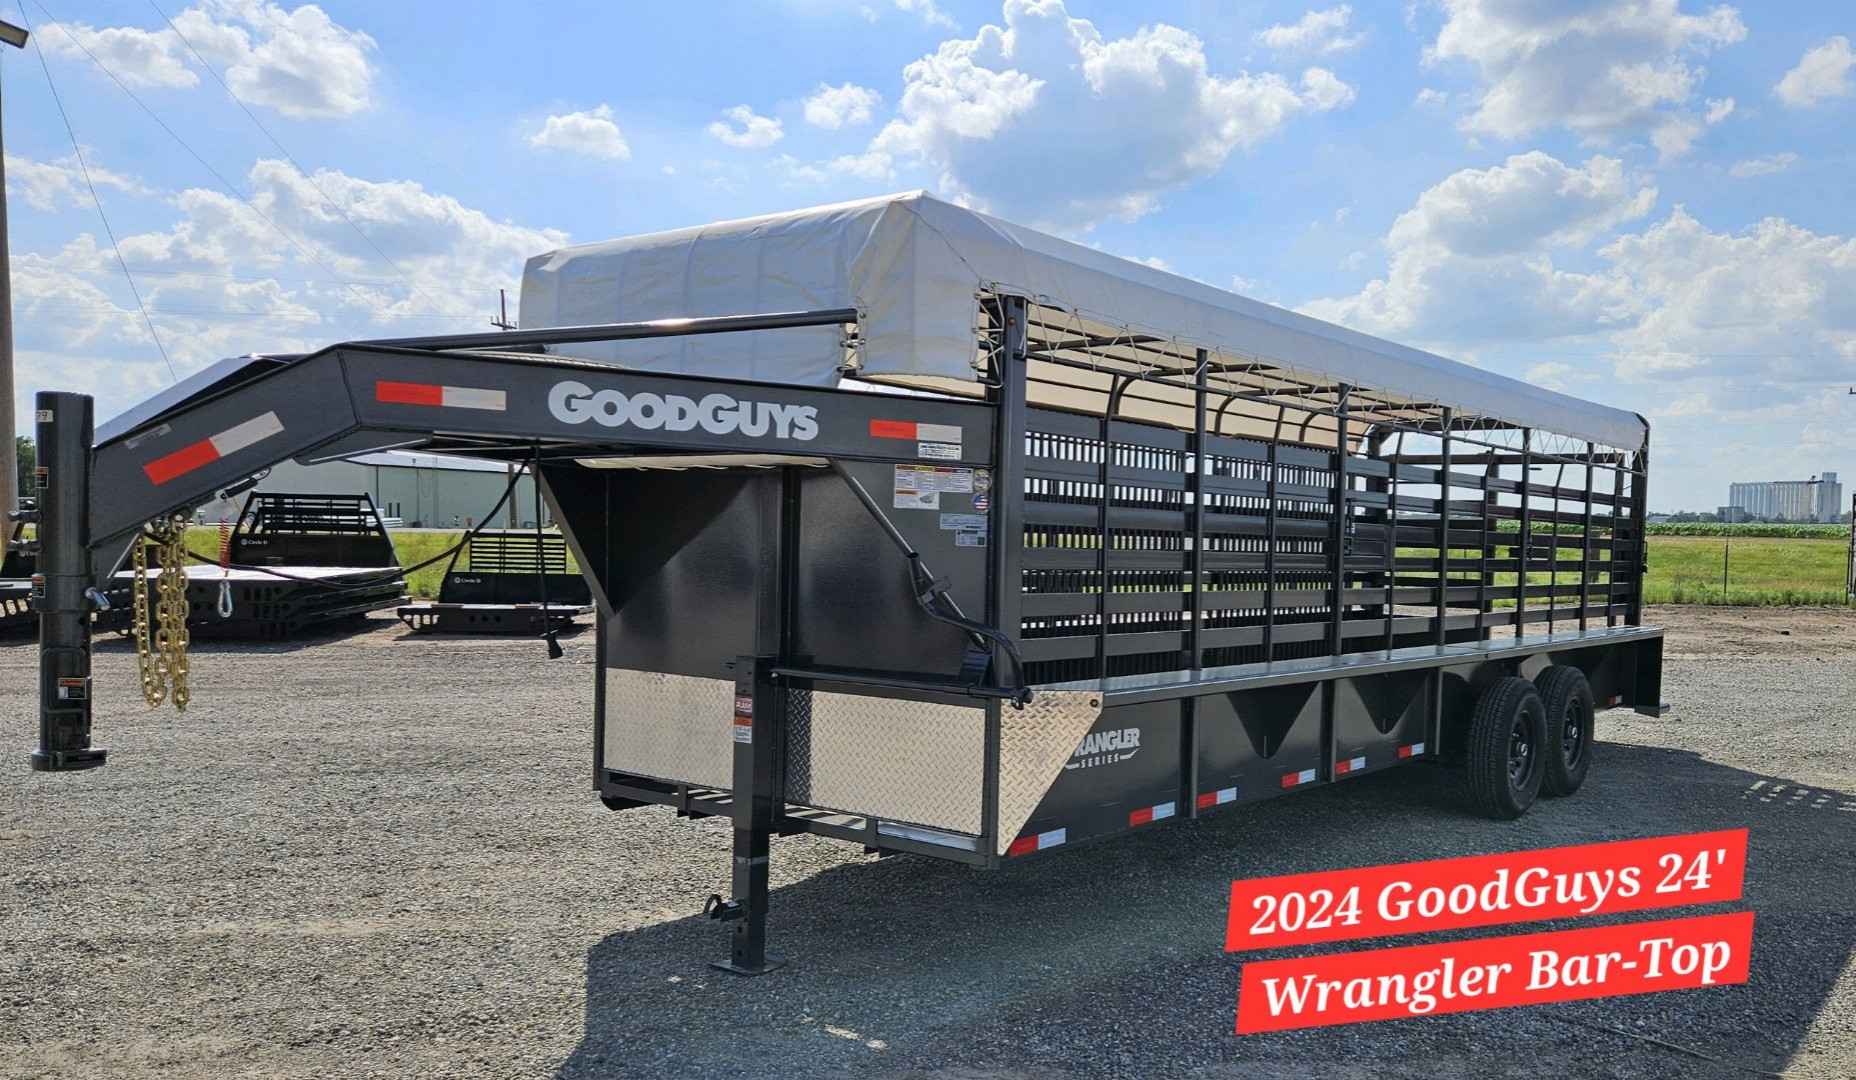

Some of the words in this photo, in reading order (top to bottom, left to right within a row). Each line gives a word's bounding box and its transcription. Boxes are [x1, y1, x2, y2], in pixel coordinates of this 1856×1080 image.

[548, 380, 819, 441] GOODGUYS
[1074, 728, 1140, 757] RANGLER
[1081, 753, 1119, 769] SERIES
